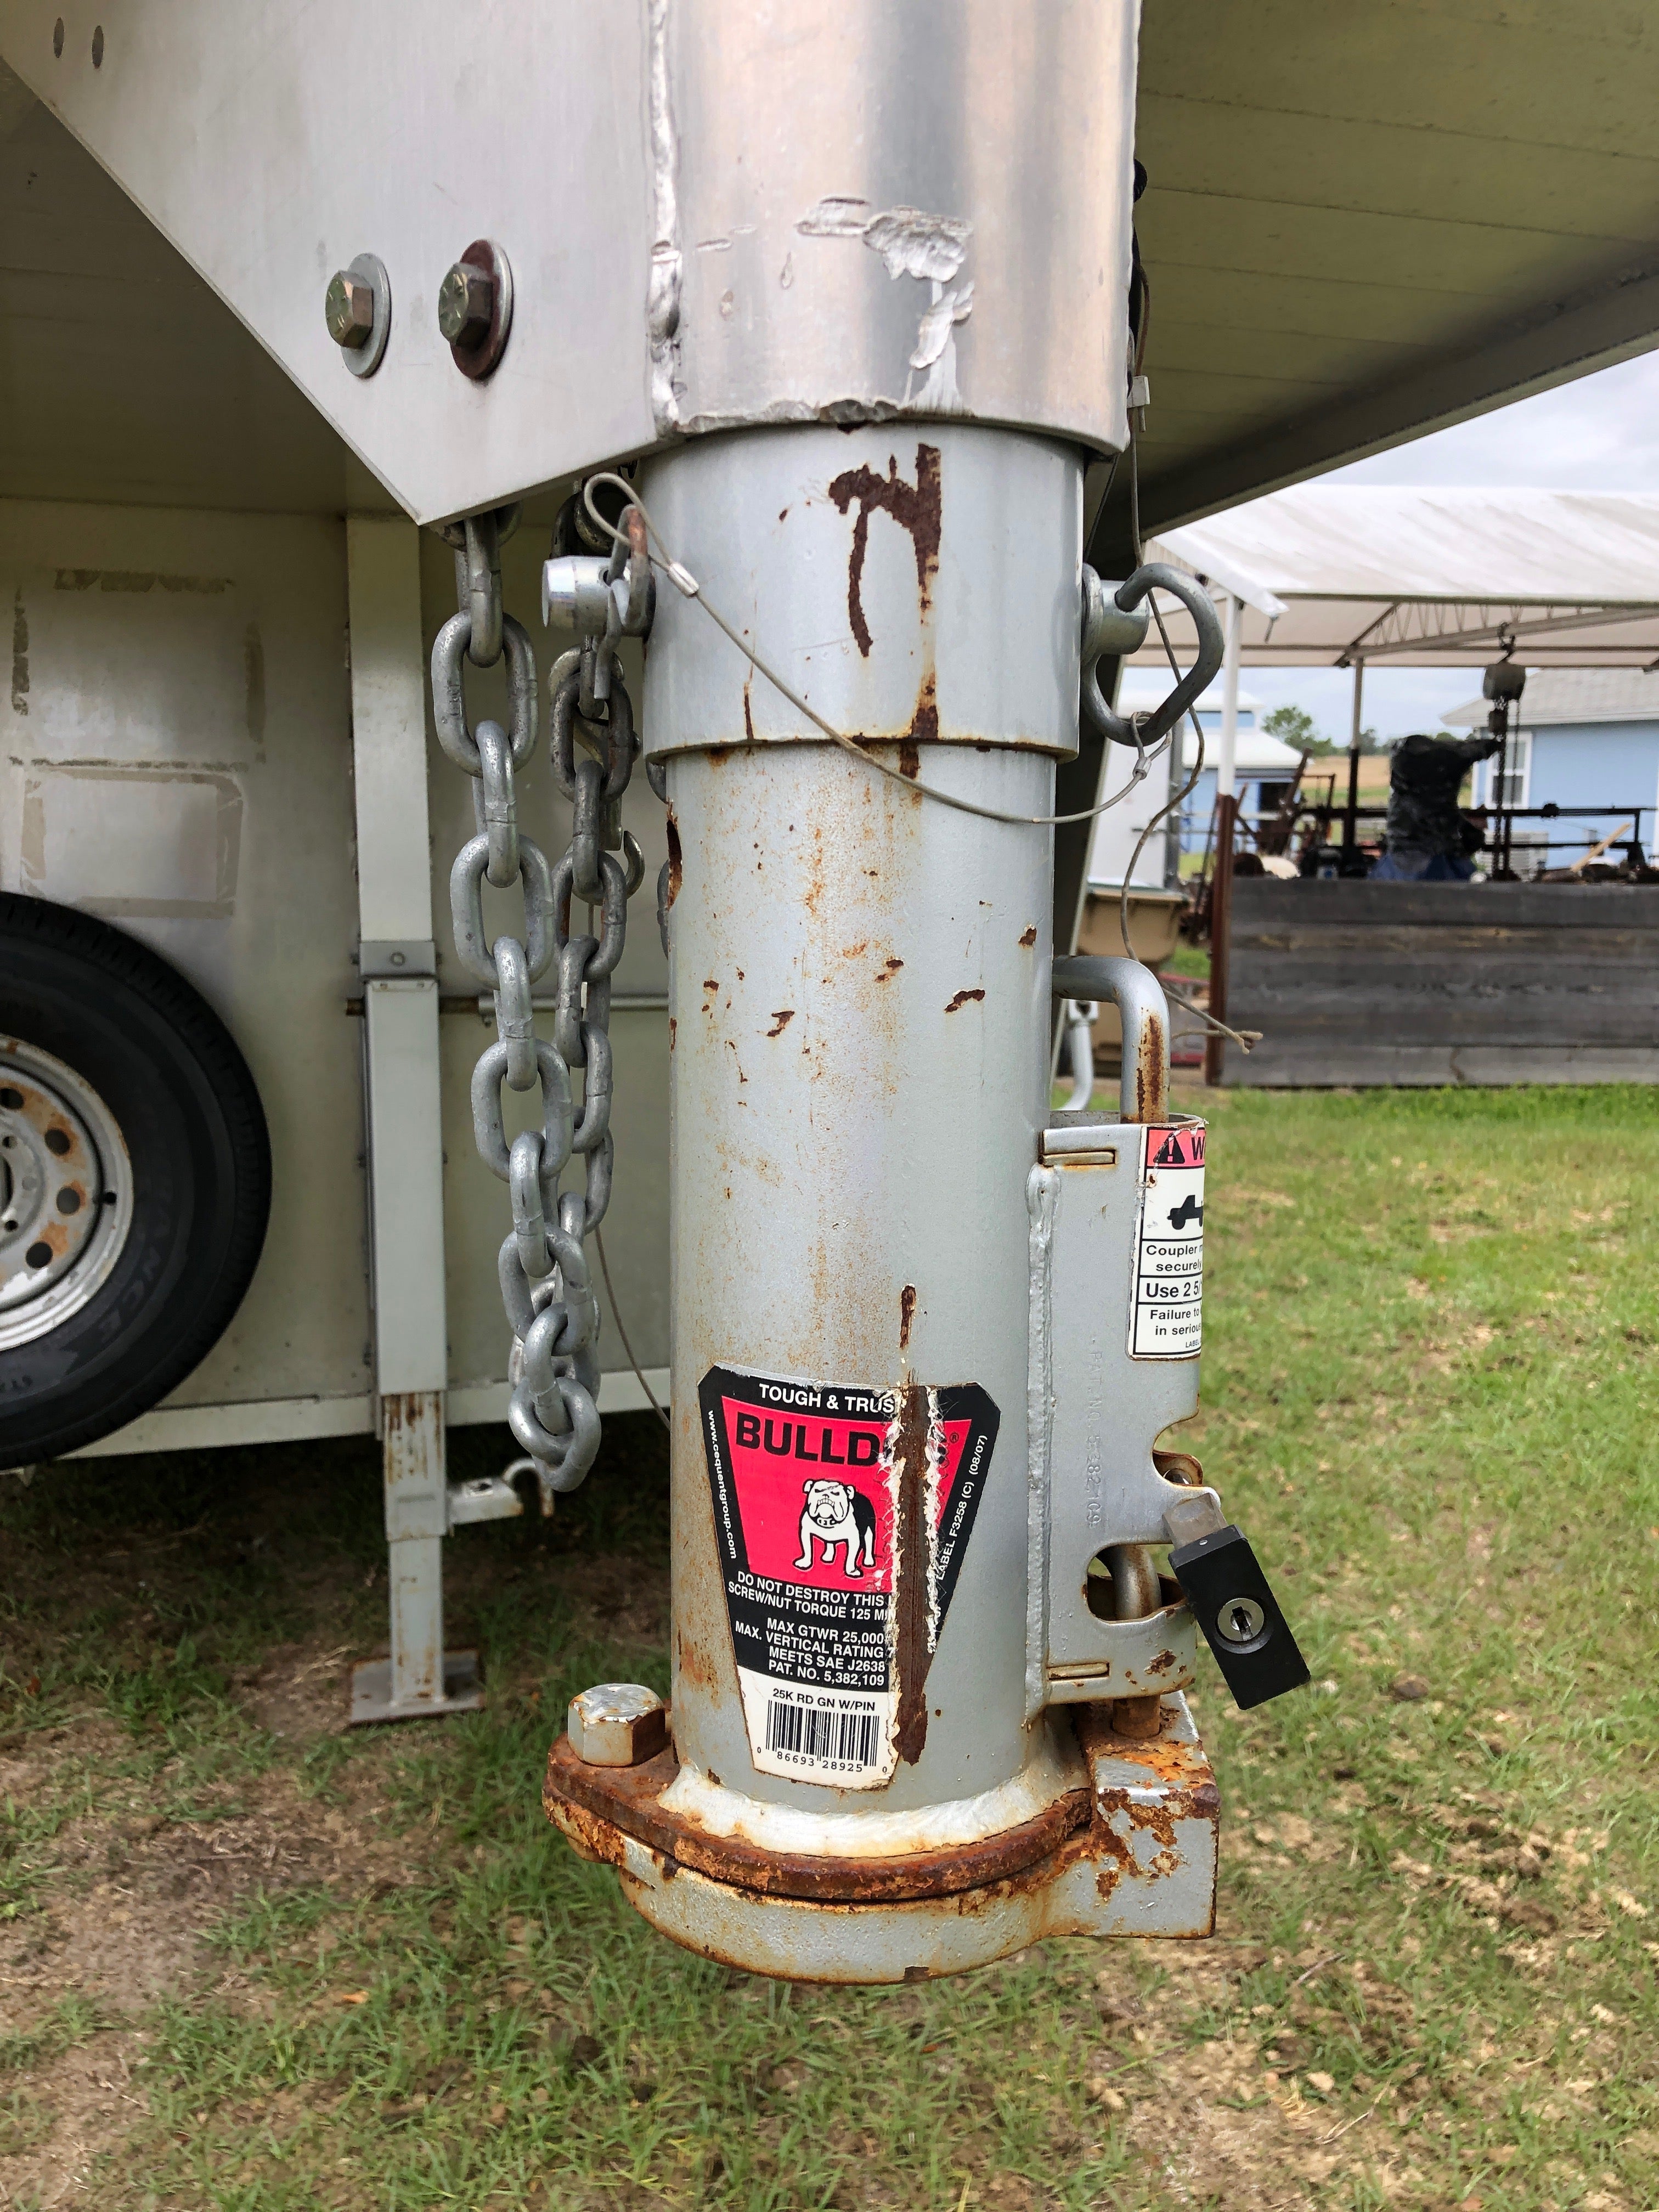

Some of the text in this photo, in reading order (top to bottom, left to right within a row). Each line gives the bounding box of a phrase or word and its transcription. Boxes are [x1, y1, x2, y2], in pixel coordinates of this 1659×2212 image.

[1146, 1245, 1198, 1257] Coupler
[1155, 1259, 1201, 1272] securely
[1146, 1283, 1179, 1298] Use
[1183, 1282, 1190, 1296] 2
[1150, 1308, 1191, 1321] Failure
[1193, 1307, 1199, 1317] to
[1155, 1323, 1201, 1335] in serious
[1186, 1339, 1199, 1348] LABEL
[759, 1384, 895, 1413] TOUGH & TRUS
[736, 1412, 894, 1467] BULLD
[708, 1410, 737, 1559] www.cequentgroup.com
[949, 1500, 967, 1538] F3258
[961, 1481, 975, 1499] (C)
[968, 1434, 988, 1476] (08/07)
[728, 1581, 792, 1611] SCREW/NUT
[794, 1602, 847, 1618] TORQUE
[850, 1607, 871, 1620] 125
[737, 1571, 754, 1585] DO
[755, 1574, 783, 1593] NOT
[785, 1581, 849, 1605] DESTROY
[853, 1593, 884, 1607] THIS
[735, 1620, 763, 1640] MAX.
[765, 1631, 830, 1655] VERTICAL
[833, 1644, 884, 1659] RATING
[766, 1617, 795, 1635] MAX
[798, 1624, 839, 1642] GTWR
[769, 1646, 886, 1673] MEETS SAE J2638
[768, 1660, 885, 1686] PAT. NO. 5,382,109
[772, 1688, 876, 1711] 25K RD GN W/PIN
[777, 1751, 815, 1767] 86693
[822, 1760, 863, 1773] 28925
